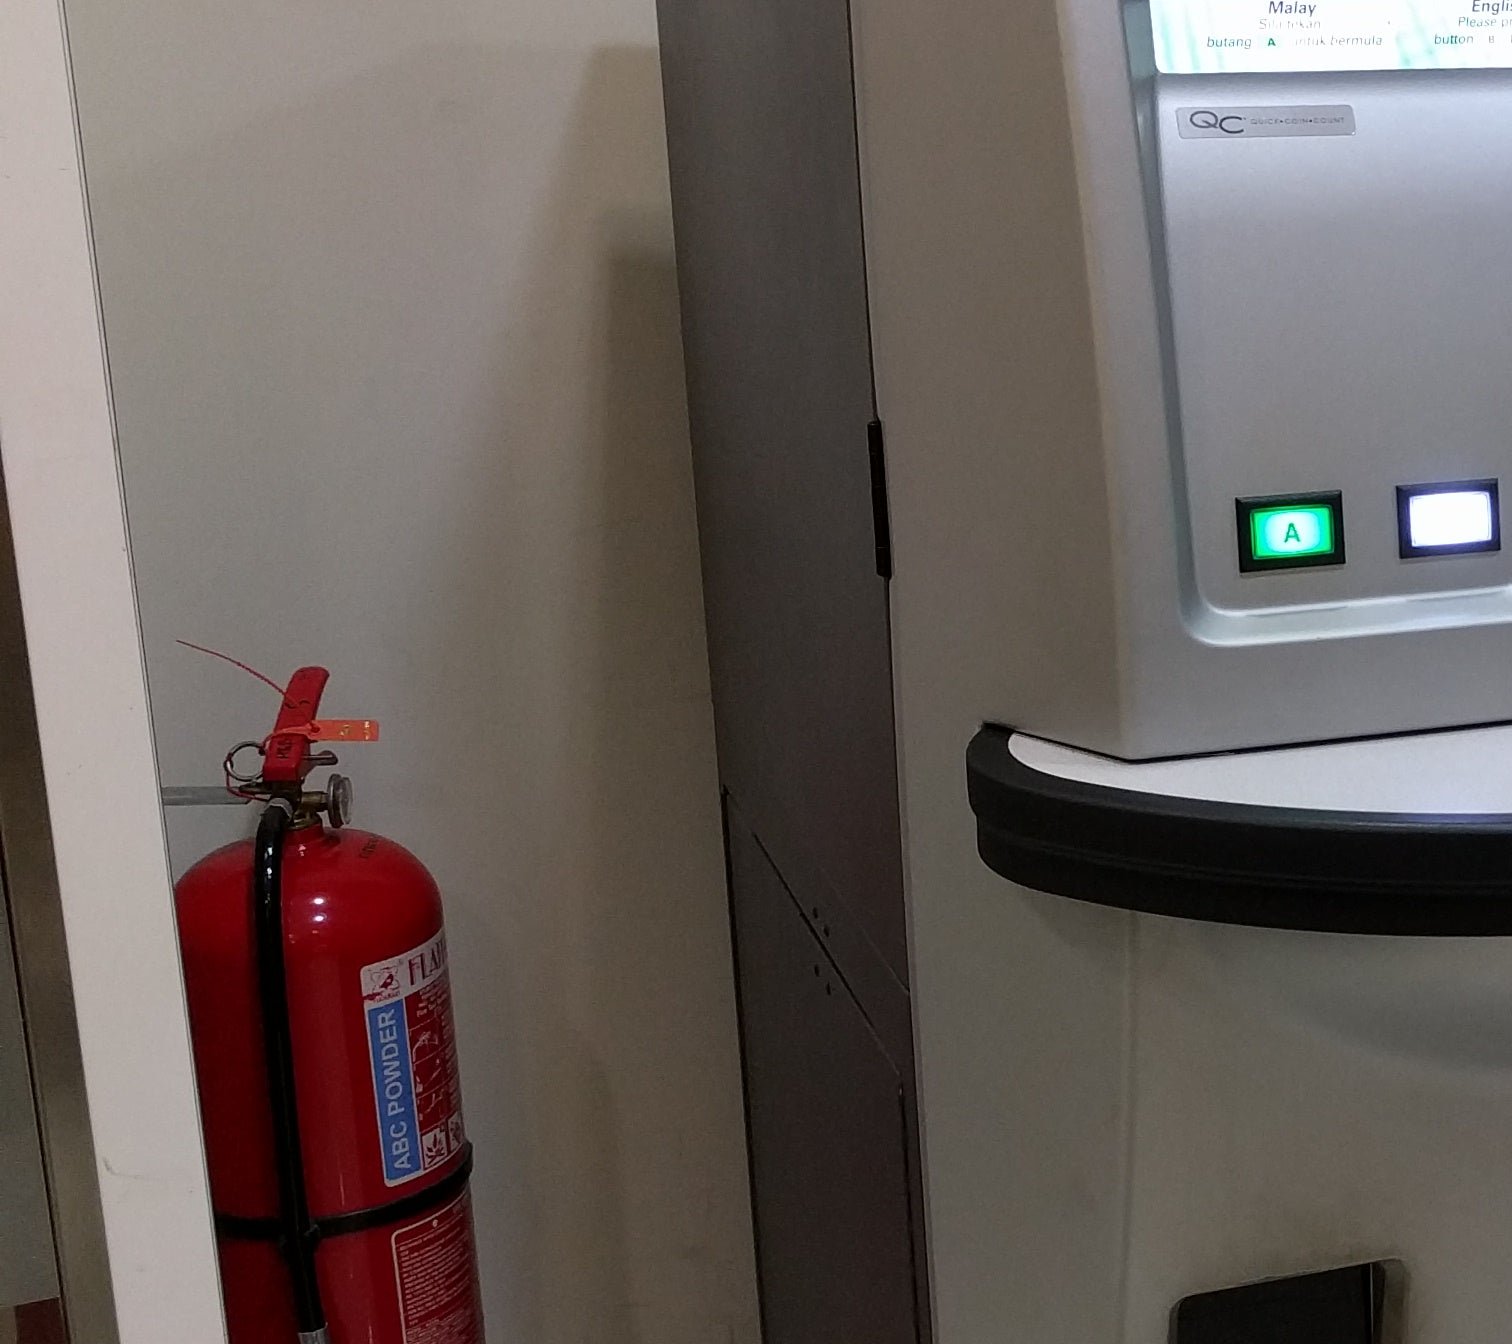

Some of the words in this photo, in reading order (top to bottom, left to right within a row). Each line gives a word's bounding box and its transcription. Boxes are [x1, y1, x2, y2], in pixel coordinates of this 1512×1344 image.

[1269, 1, 1316, 17] Malay
[1459, 17, 1496, 27] Please
[1207, 37, 1252, 49] butang
[1267, 38, 1276, 46] A
[1331, 36, 1382, 46] bermula
[1434, 35, 1473, 44] button
[1284, 522, 1300, 543] A
[378, 1008, 405, 1116] POWDER
[391, 1121, 411, 1169] ABC
